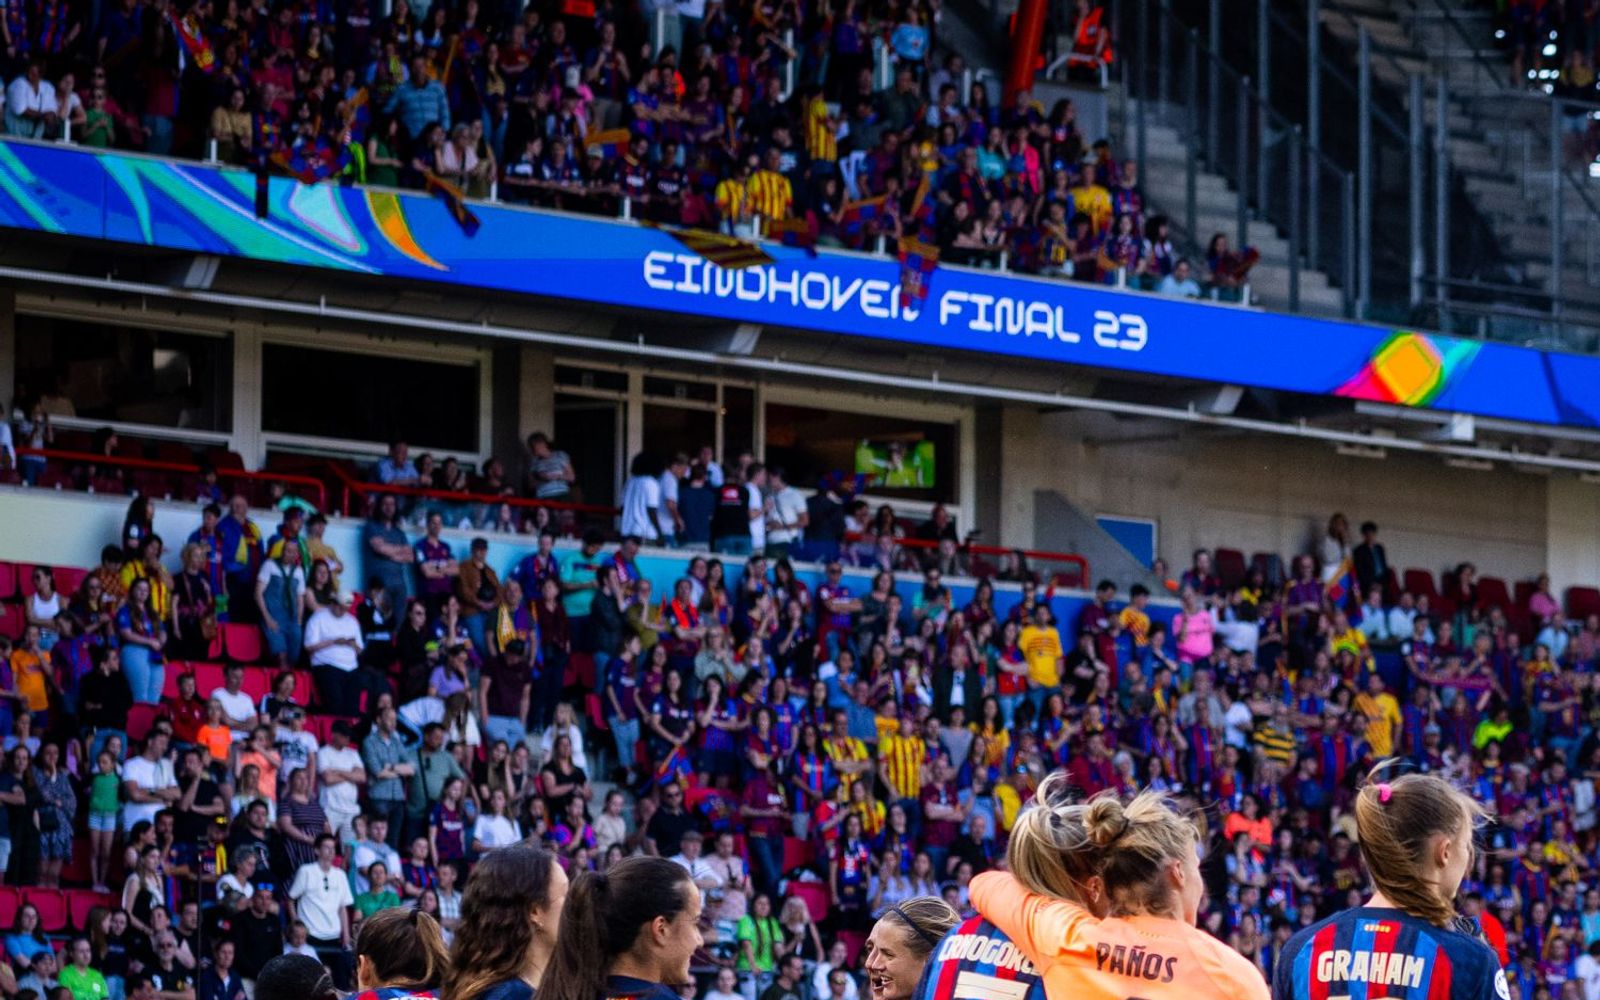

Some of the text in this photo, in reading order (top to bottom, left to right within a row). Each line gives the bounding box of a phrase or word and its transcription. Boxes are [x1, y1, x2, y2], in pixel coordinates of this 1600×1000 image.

[939, 290, 1080, 344] FINAL
[1093, 310, 1149, 351] 23
[1096, 942, 1178, 983] PAÑOS
[1317, 949, 1425, 989] GRAHAM
